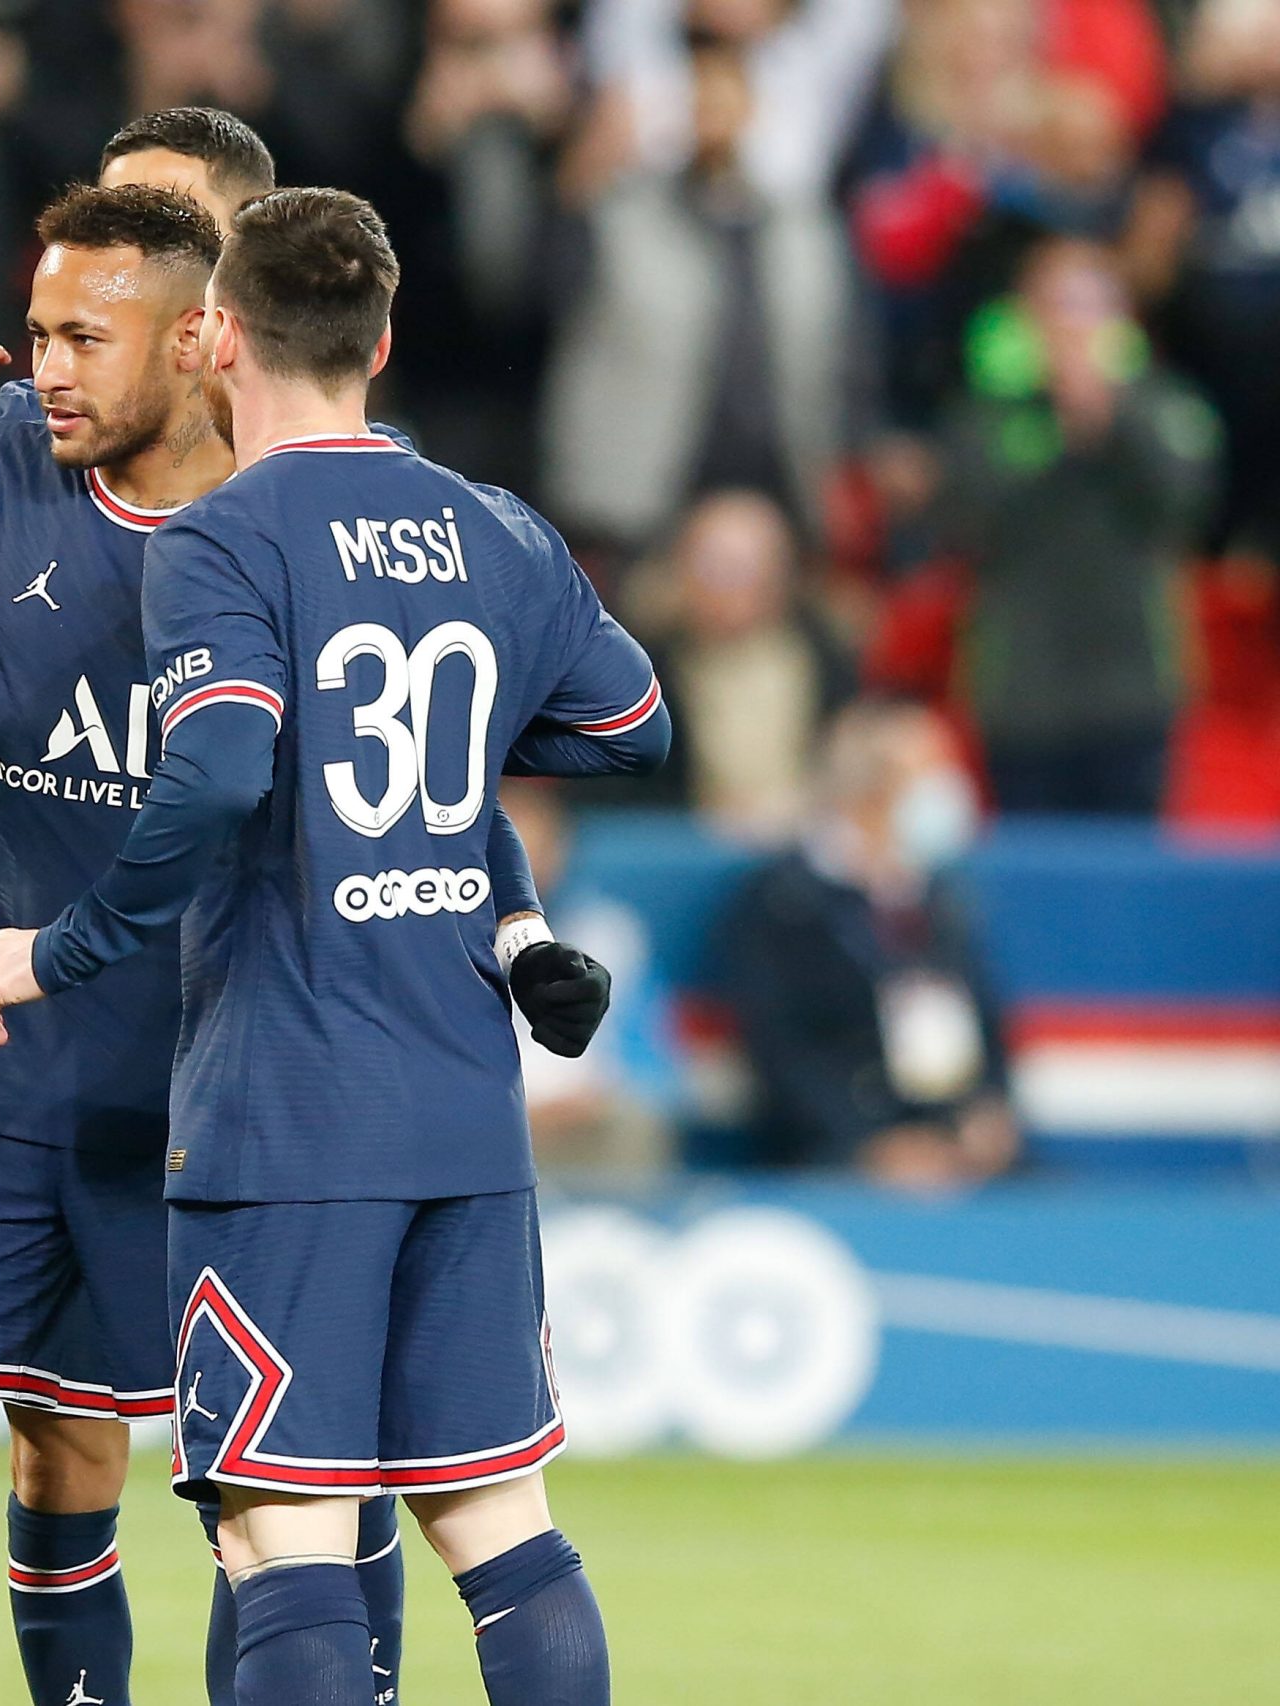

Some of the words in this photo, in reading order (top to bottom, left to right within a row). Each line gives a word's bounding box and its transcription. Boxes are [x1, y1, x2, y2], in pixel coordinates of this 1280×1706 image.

[151, 647, 213, 710] QNB
[40, 674, 152, 779] AL
[316, 620, 498, 839] 30
[63, 776, 124, 807] LIVE
